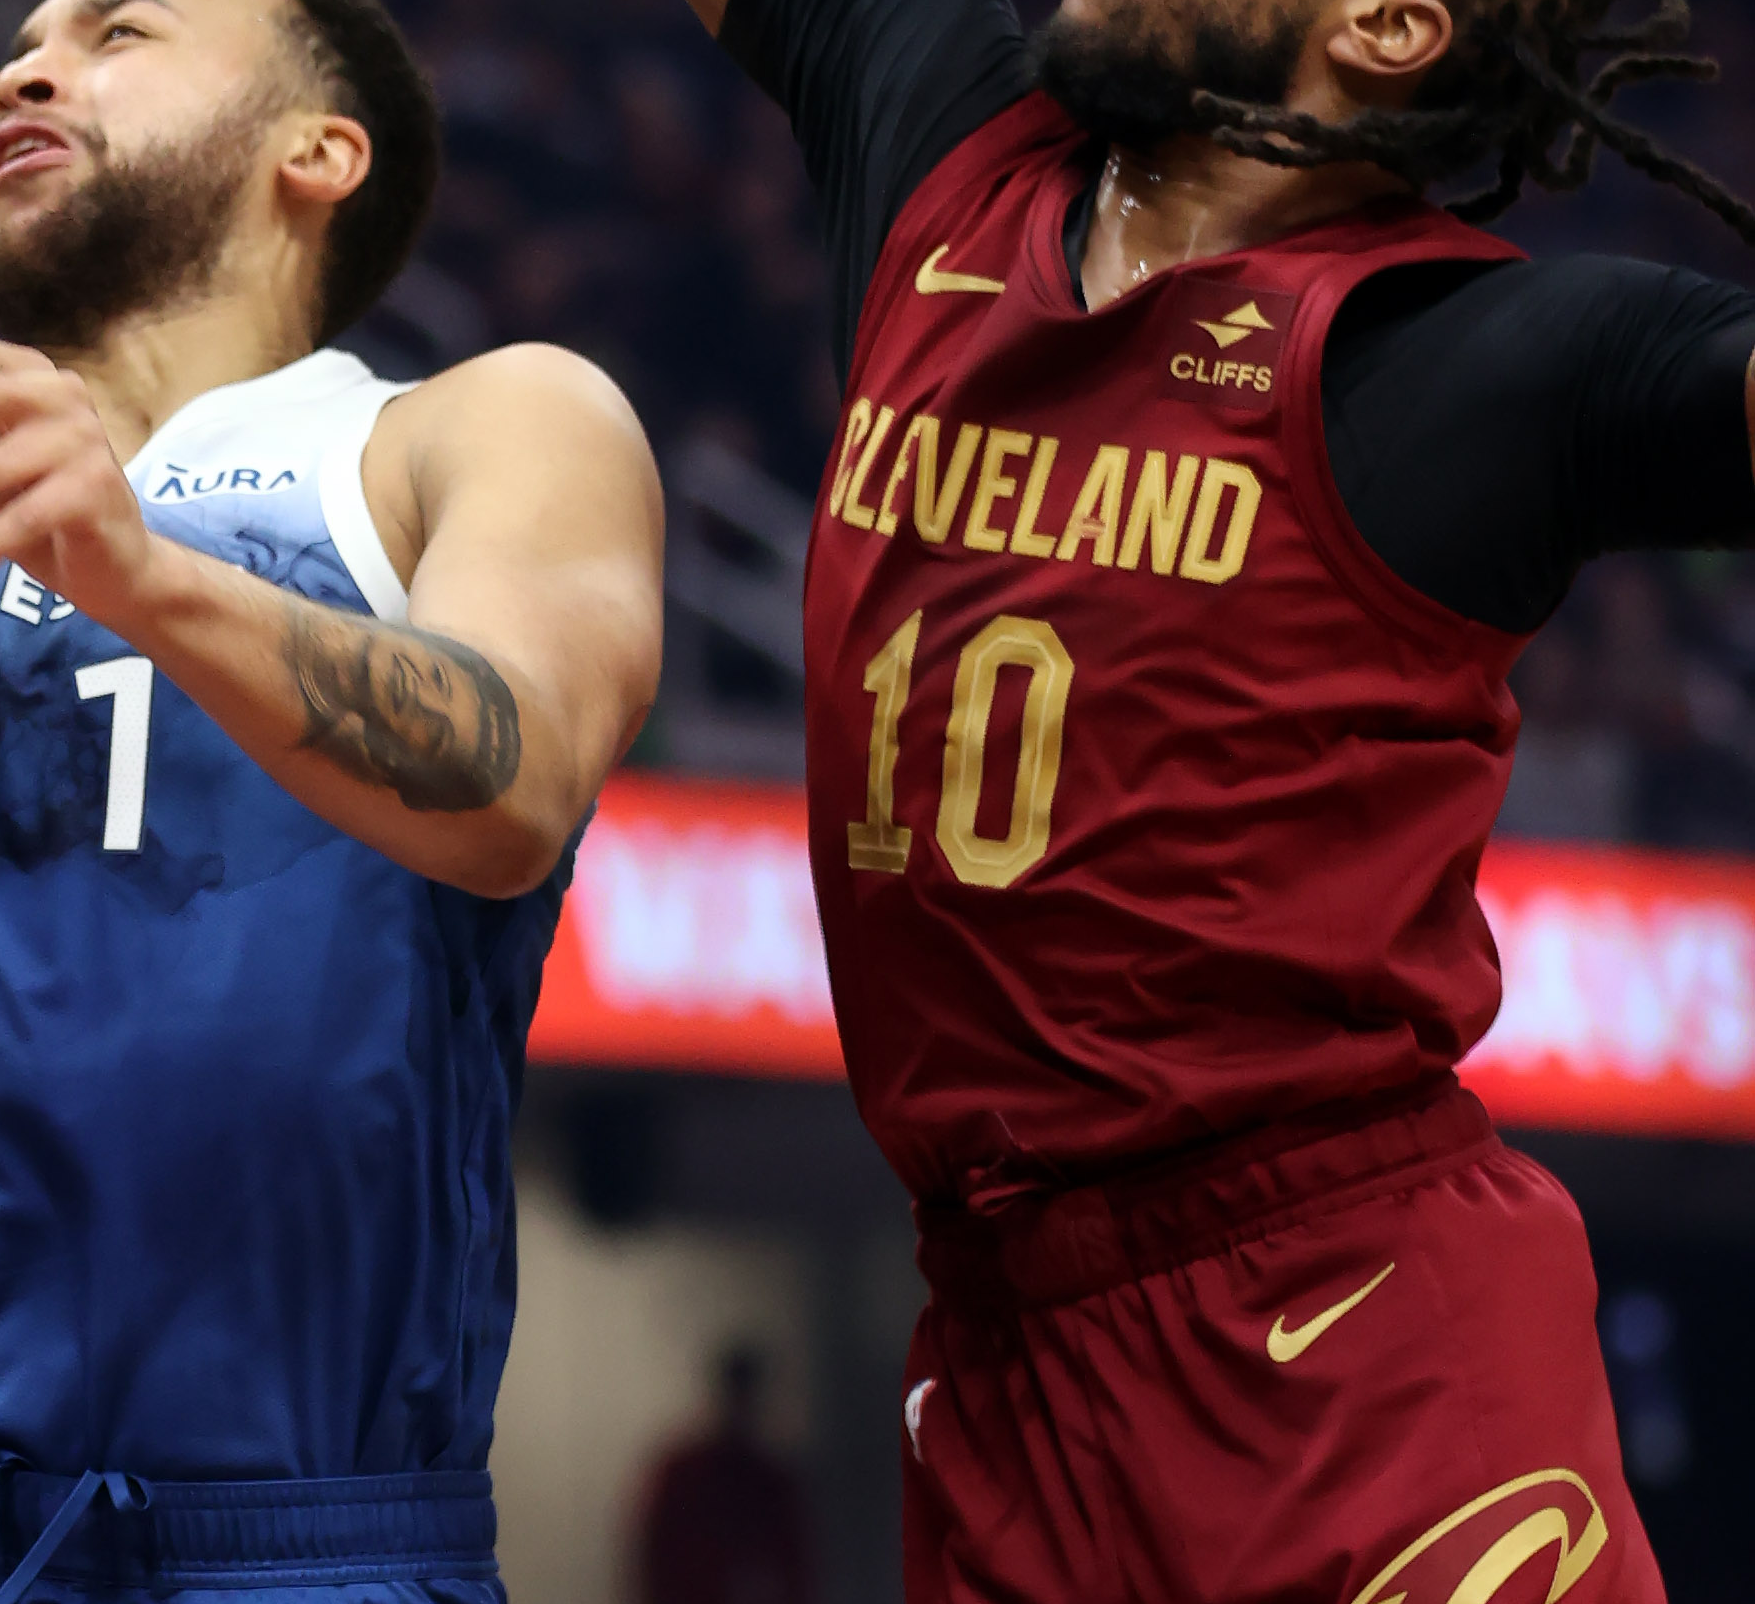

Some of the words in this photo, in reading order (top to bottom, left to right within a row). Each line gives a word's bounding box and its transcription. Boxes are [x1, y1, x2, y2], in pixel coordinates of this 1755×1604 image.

[1169, 351, 1273, 393] CLIFFS
[829, 396, 1263, 586] CLEVELAND
[74, 655, 154, 852] 1
[847, 608, 1076, 890] 10
